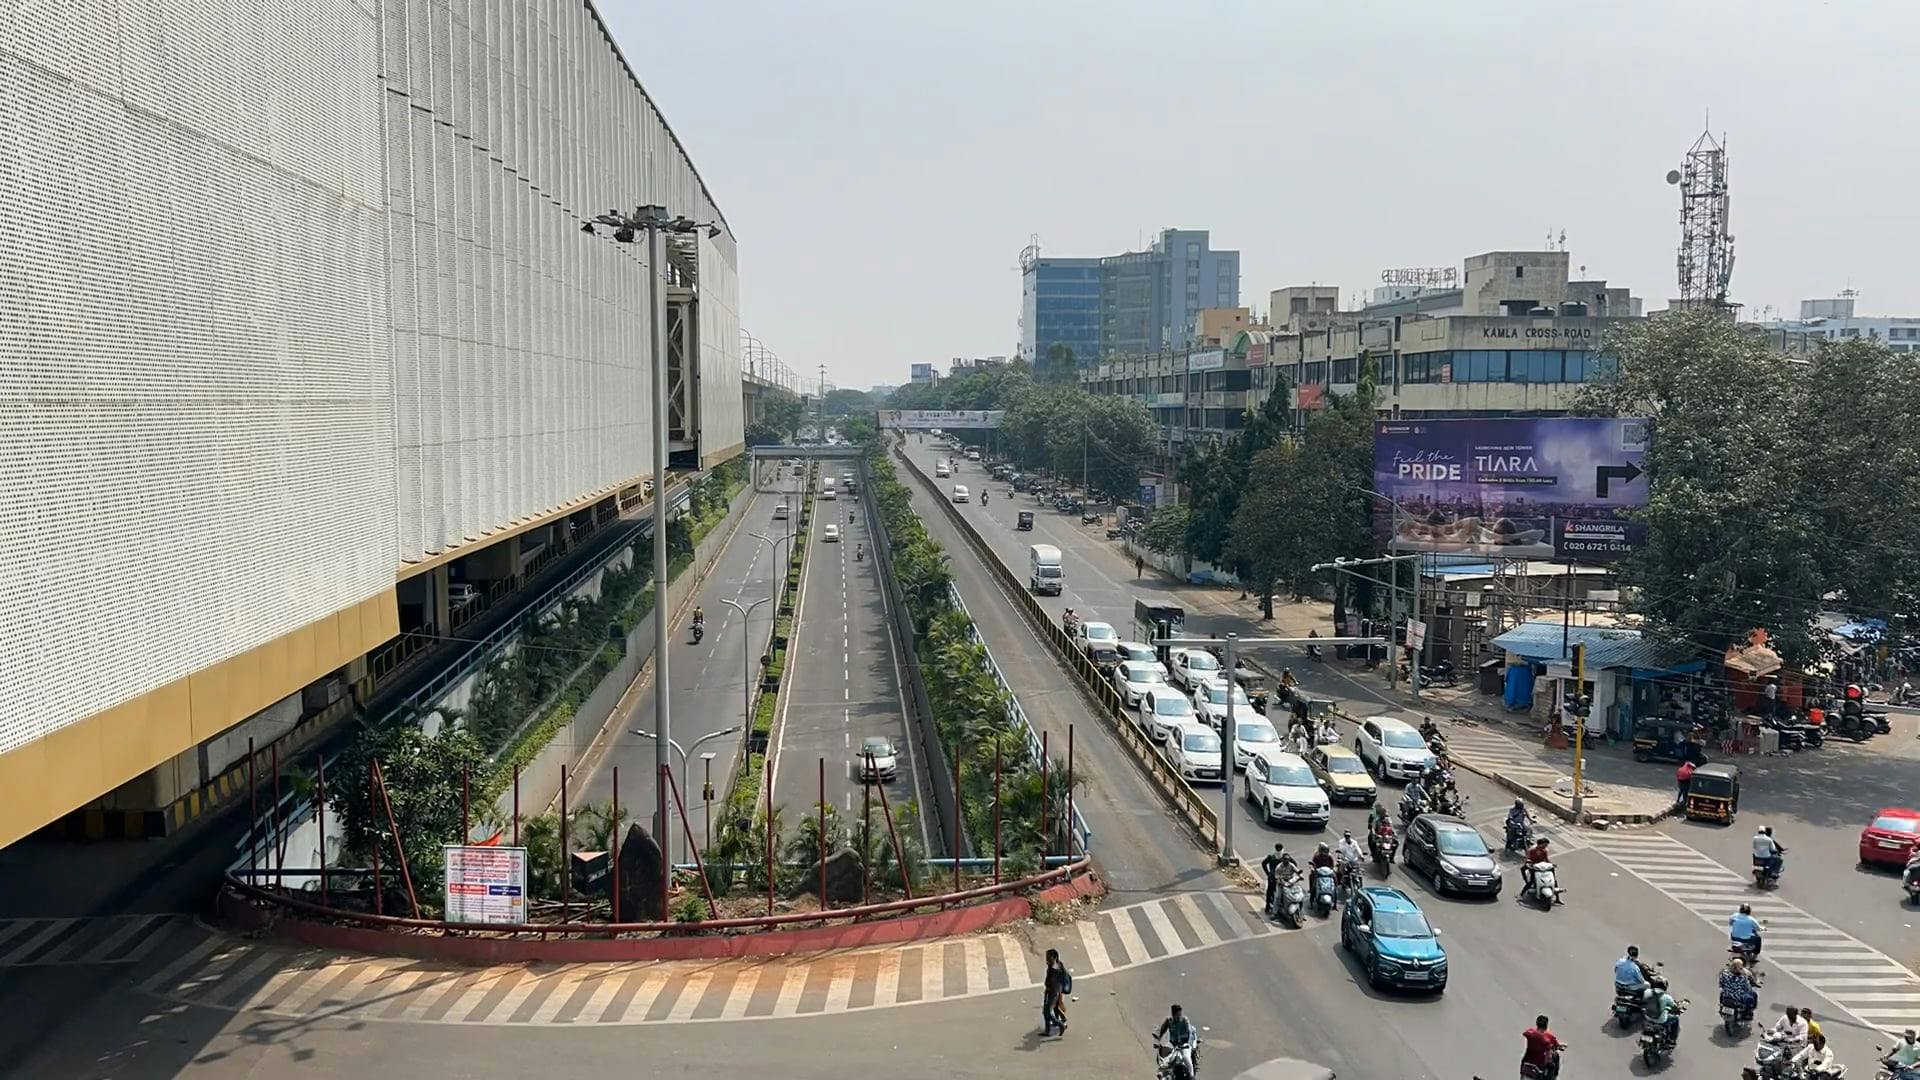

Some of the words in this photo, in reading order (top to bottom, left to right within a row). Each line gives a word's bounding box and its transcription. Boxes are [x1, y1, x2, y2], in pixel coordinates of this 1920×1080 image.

[1483, 328, 1518, 338] KAMLA
[1525, 328, 1591, 339] CROSS-ROAD
[1393, 450, 1424, 467] feel
[1428, 450, 1455, 462] the
[1475, 454, 1538, 472] TIARA
[1399, 463, 1461, 480] PRIDE
[1575, 524, 1624, 533] SHANGRILA
[1569, 542, 1585, 550] 020
